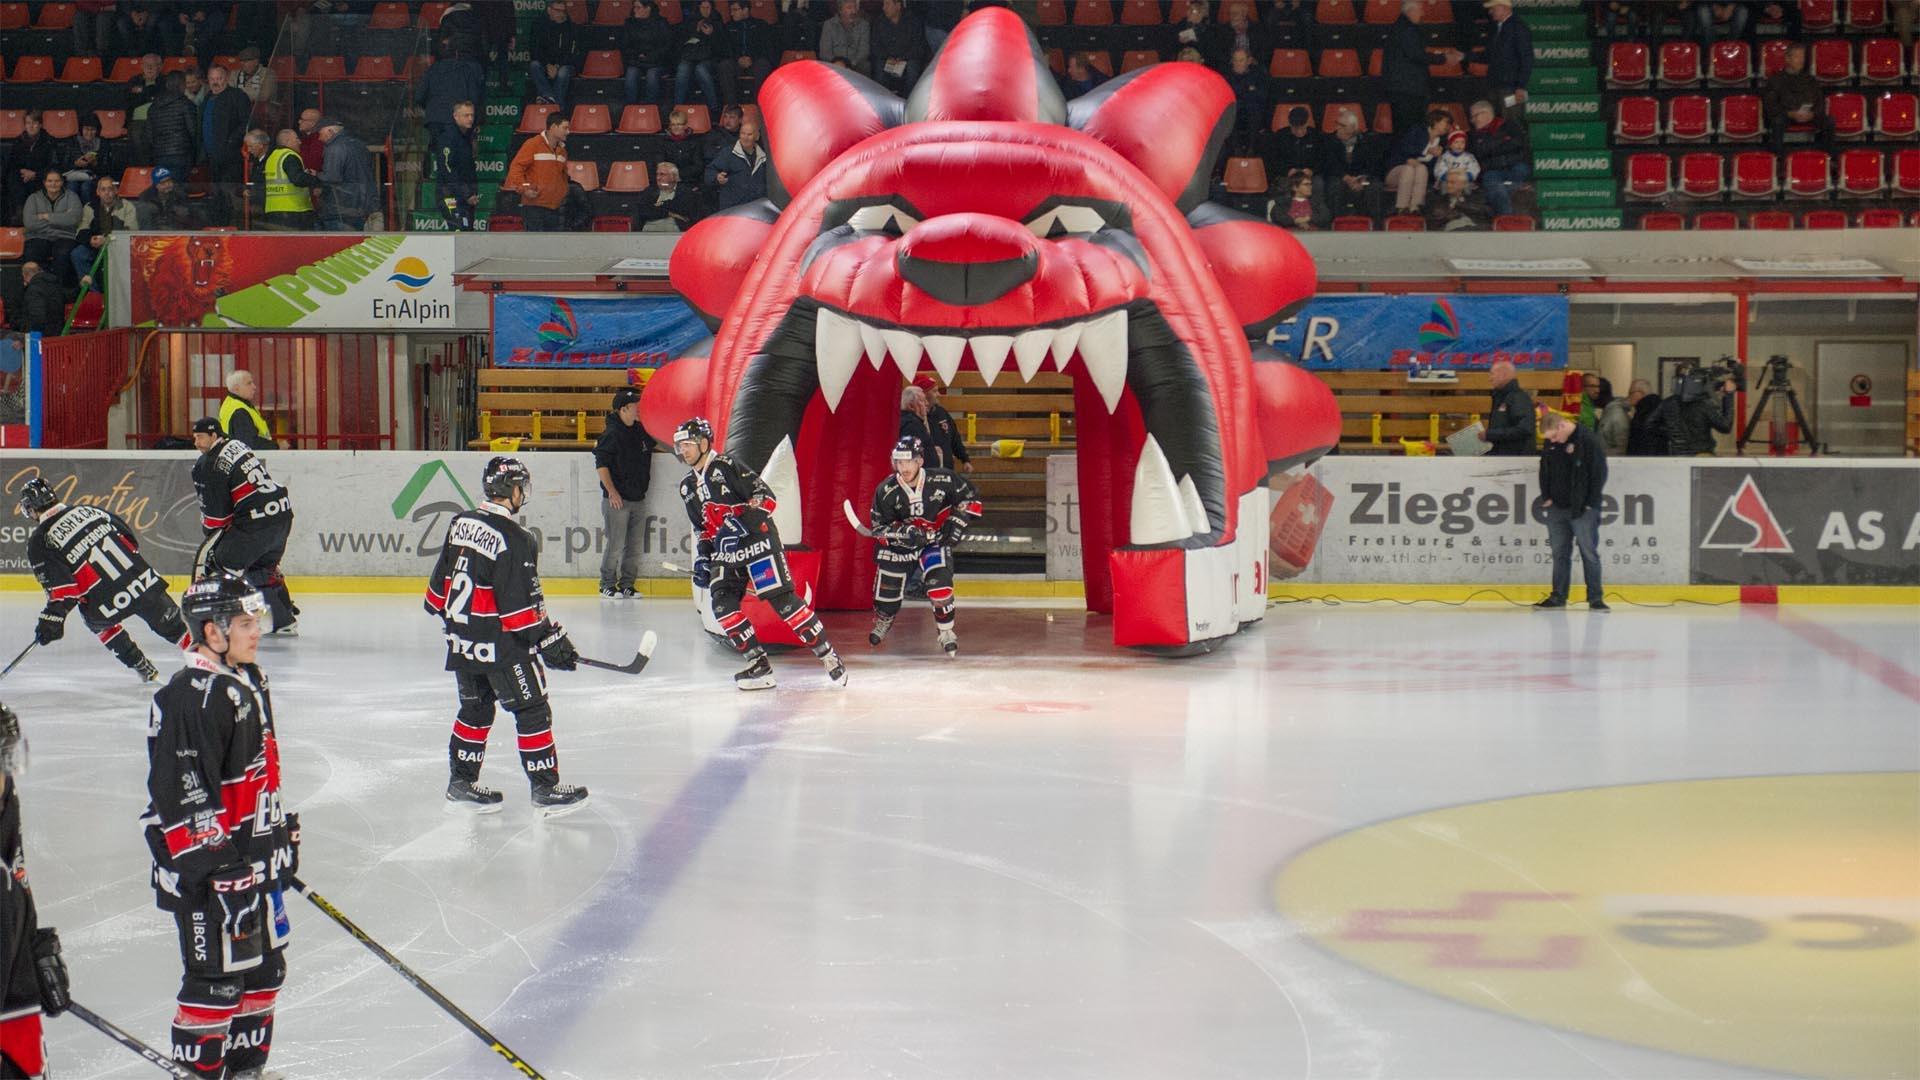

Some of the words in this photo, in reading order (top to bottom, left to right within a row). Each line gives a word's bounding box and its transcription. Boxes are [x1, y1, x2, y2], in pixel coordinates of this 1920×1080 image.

[373, 299, 450, 323] EnAlpin
[909, 502, 924, 516] 13
[1816, 510, 1886, 550] AS
[1349, 536, 1455, 548] Freiburg
[1471, 536, 1483, 547] &
[1631, 536, 1658, 547] AG
[88, 535, 134, 581] 11
[1463, 553, 1524, 564] Telefon
[1641, 553, 1661, 564] 99
[527, 757, 555, 772] BAU
